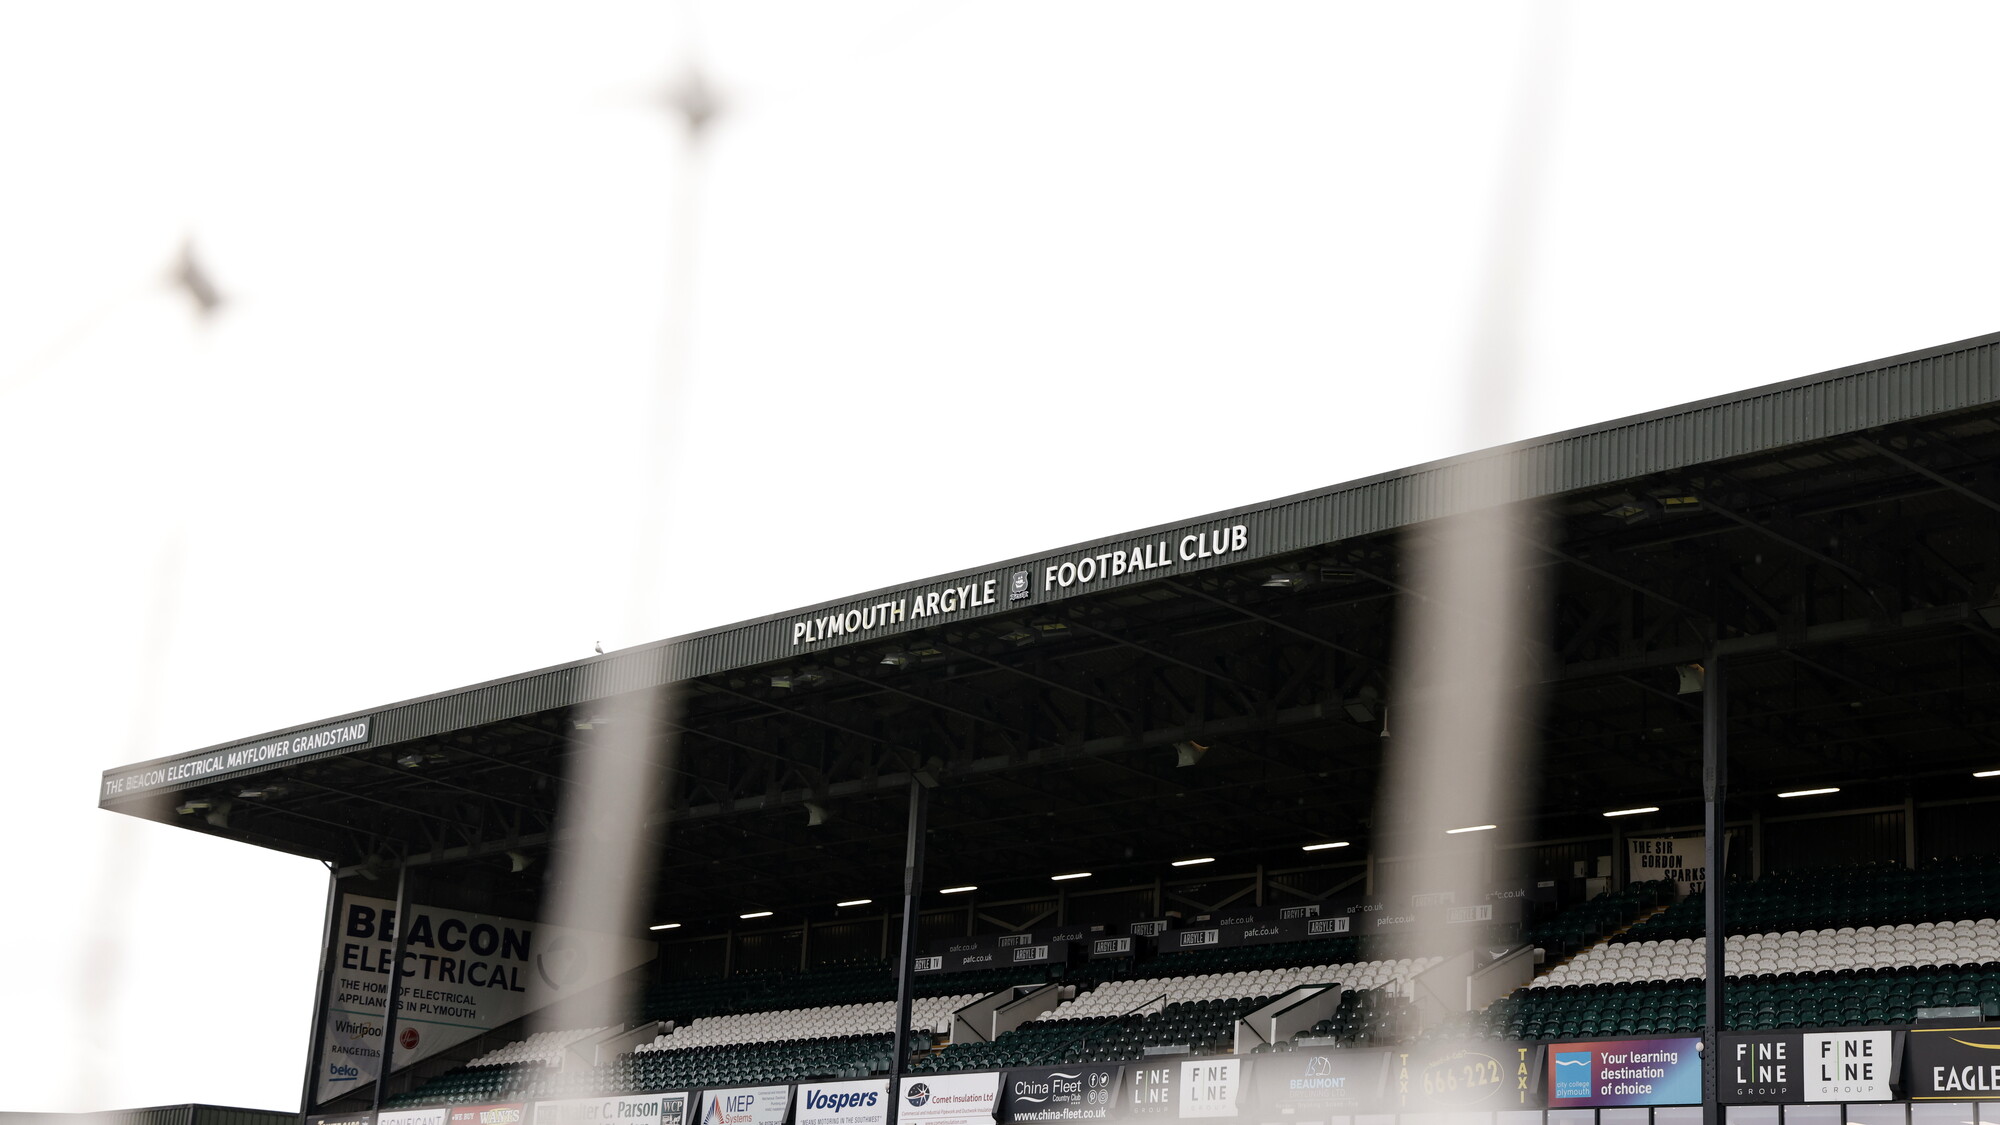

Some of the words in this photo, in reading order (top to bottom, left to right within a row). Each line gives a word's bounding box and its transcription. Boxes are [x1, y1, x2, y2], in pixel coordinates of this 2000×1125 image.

[792, 599, 905, 645] PLYMOUTH
[911, 579, 996, 620] ARGYLE
[1045, 541, 1172, 591] FOOTBALL
[1179, 525, 1248, 563] CLUB
[106, 779, 124, 795] THE
[126, 769, 166, 790] BEACON
[167, 756, 224, 782] ELECTRICAL
[227, 739, 289, 768] MAYFLOWER
[292, 723, 365, 753] GRANDSTAND
[1633, 840, 1651, 854] THE
[1656, 841, 1672, 854] SIR
[1642, 854, 1682, 868] GORDON
[1664, 868, 1706, 882] SPARKS
[1480, 906, 1488, 918] TV
[1310, 920, 1333, 932] ARGYLE
[1338, 919, 1346, 930] TV
[1377, 914, 1415, 926] pafc.co.uk
[346, 904, 532, 962] BEACON
[1133, 923, 1153, 936] ARGYLE
[1244, 926, 1279, 939] pafc.co.uk
[1182, 932, 1204, 946] ARGYLE
[1208, 931, 1216, 942] TV
[1096, 940, 1116, 952] ARGYLE
[1120, 939, 1128, 950] TV
[962, 953, 992, 965] pafc.co.uk
[1016, 948, 1035, 960] ARGYLE
[1038, 948, 1045, 958] TV
[342, 943, 525, 992] ELECTRICAL
[914, 959, 930, 970] RGYLE
[934, 958, 940, 968] TV
[340, 978, 360, 990] THE
[362, 981, 388, 994] HOM
[414, 988, 476, 1006] ELECTRICAL
[406, 1002, 417, 1012] IN
[420, 1003, 476, 1019] PLYMOUTH
[1601, 1052, 1627, 1064] Your
[1630, 1050, 1678, 1064] learning
[330, 1063, 358, 1076] beko
[1517, 1048, 1528, 1104] TAXI
[1601, 1067, 1664, 1080] destination
[1290, 1078, 1345, 1089] BEAUMONT
[1400, 1054, 1409, 1107] TAXI
[1423, 1060, 1500, 1095] 666-222
[1934, 1066, 2000, 1091] EAGLE
[1015, 1081, 1048, 1095] China
[1053, 1079, 1082, 1093] Fleet
[1556, 1082, 1568, 1090] city
[1569, 1081, 1590, 1090] college
[1601, 1084, 1613, 1096] of
[1614, 1083, 1652, 1096] choice
[1822, 1086, 1874, 1094] GROUP
[932, 1094, 952, 1104] Comet
[953, 1094, 982, 1103] Insulation
[983, 1092, 994, 1102] Ltd
[1053, 1094, 1070, 1102] Country
[1290, 1089, 1329, 1098] DRYLINING
[1332, 1088, 1346, 1097] LTD
[1556, 1087, 1590, 1098] plymouth
[663, 1100, 682, 1112] WCP
[726, 1094, 754, 1112] MEP
[806, 1090, 878, 1113] Vospers
[602, 1102, 613, 1119] C.
[617, 1100, 658, 1118] Parson
[1014, 1108, 1106, 1122] www.china-fleet.co.uk
[1134, 1106, 1168, 1114] GROUP
[724, 1113, 752, 1125] Systems
[846, 1116, 854, 1124] THE
